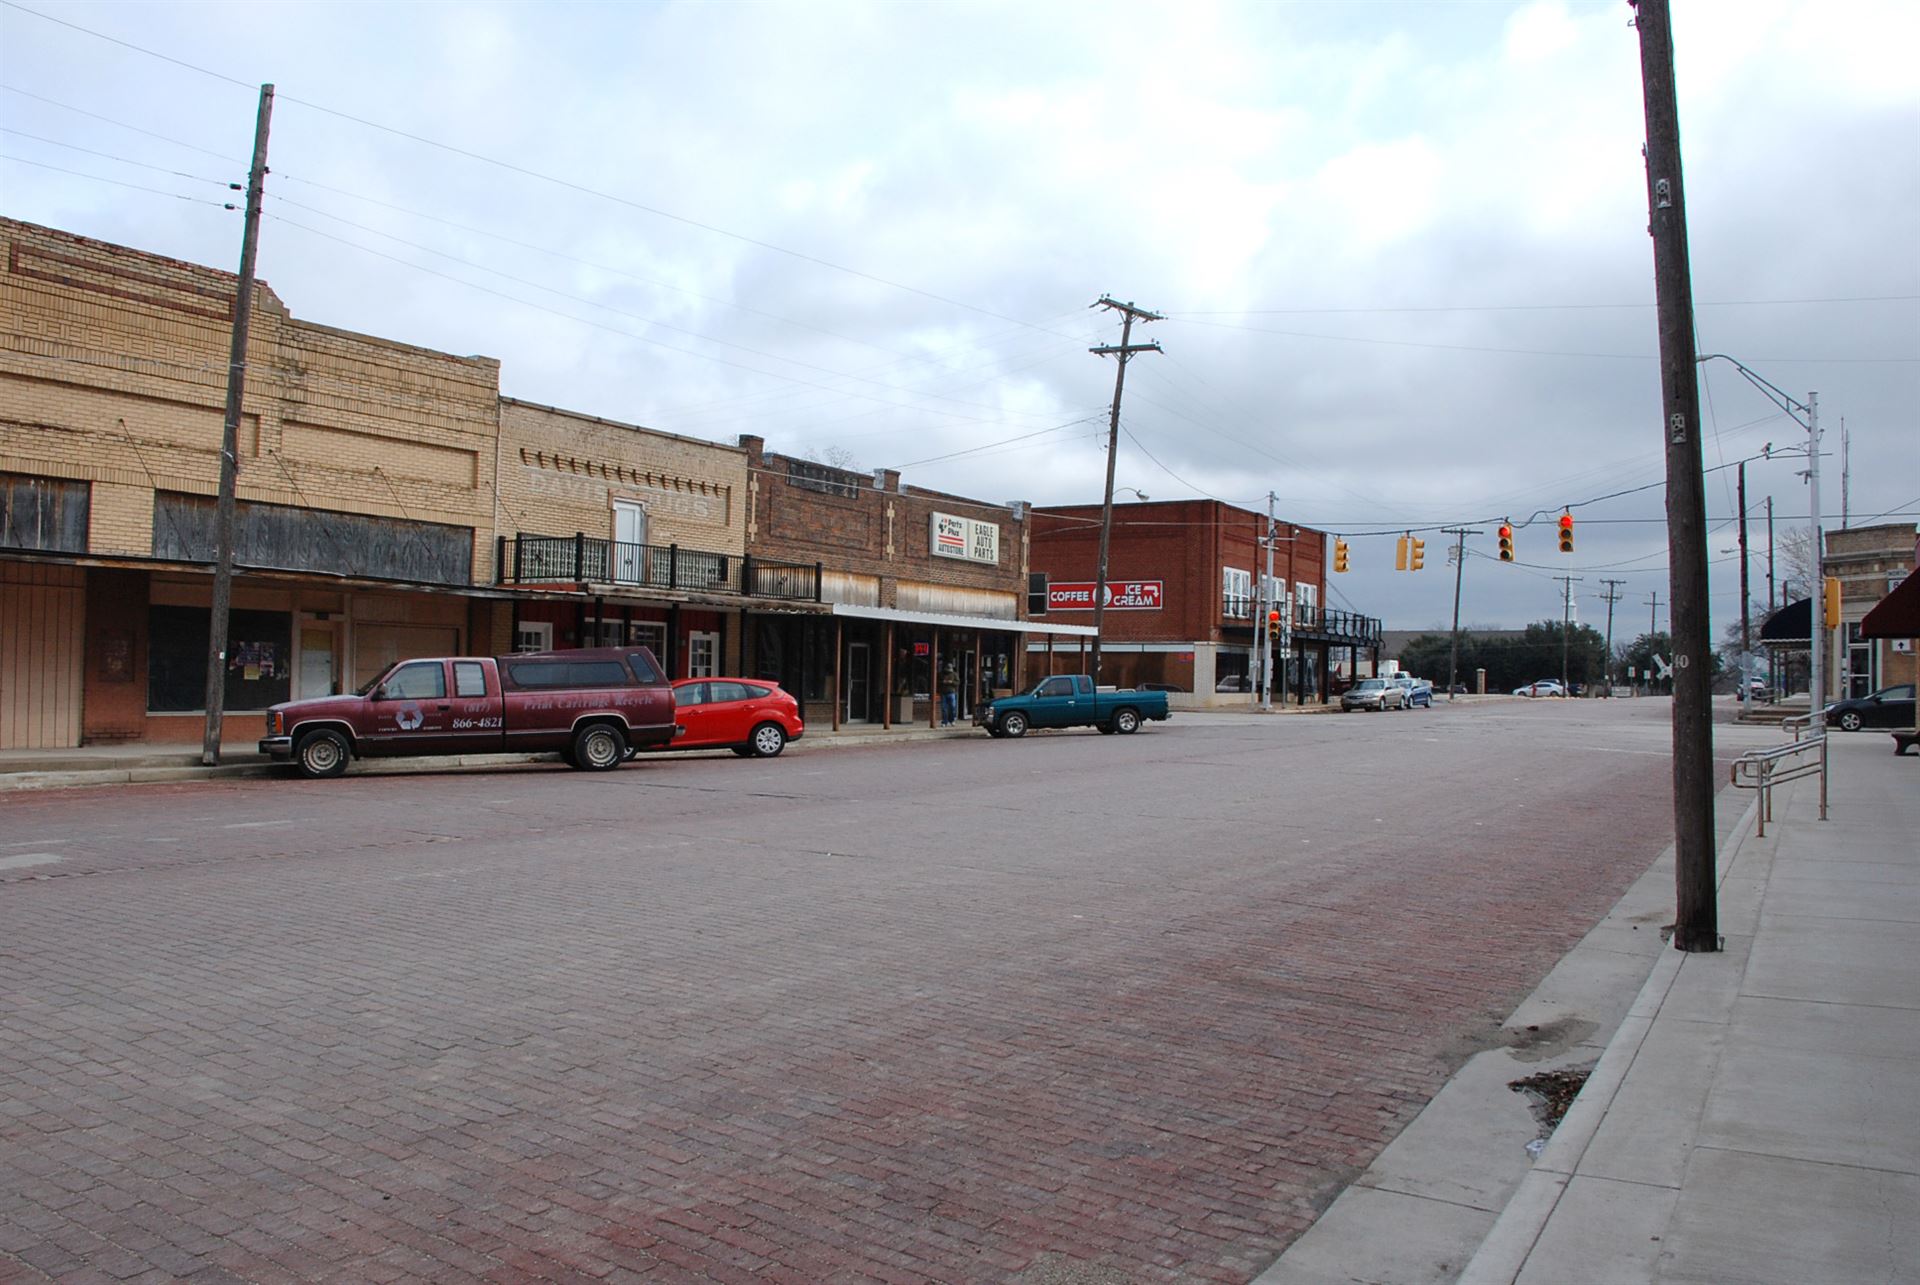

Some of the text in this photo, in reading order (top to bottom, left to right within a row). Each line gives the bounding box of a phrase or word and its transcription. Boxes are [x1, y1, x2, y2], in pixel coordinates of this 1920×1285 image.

[975, 523, 993, 538] EAGLE
[976, 535, 993, 549] AUTO
[974, 546, 994, 560] PARTS
[1125, 584, 1142, 595] ICE
[1050, 591, 1089, 602] COFFEE
[1113, 595, 1154, 606] CREAM
[463, 703, 491, 713] (817)
[452, 716, 503, 729] 866-4821
